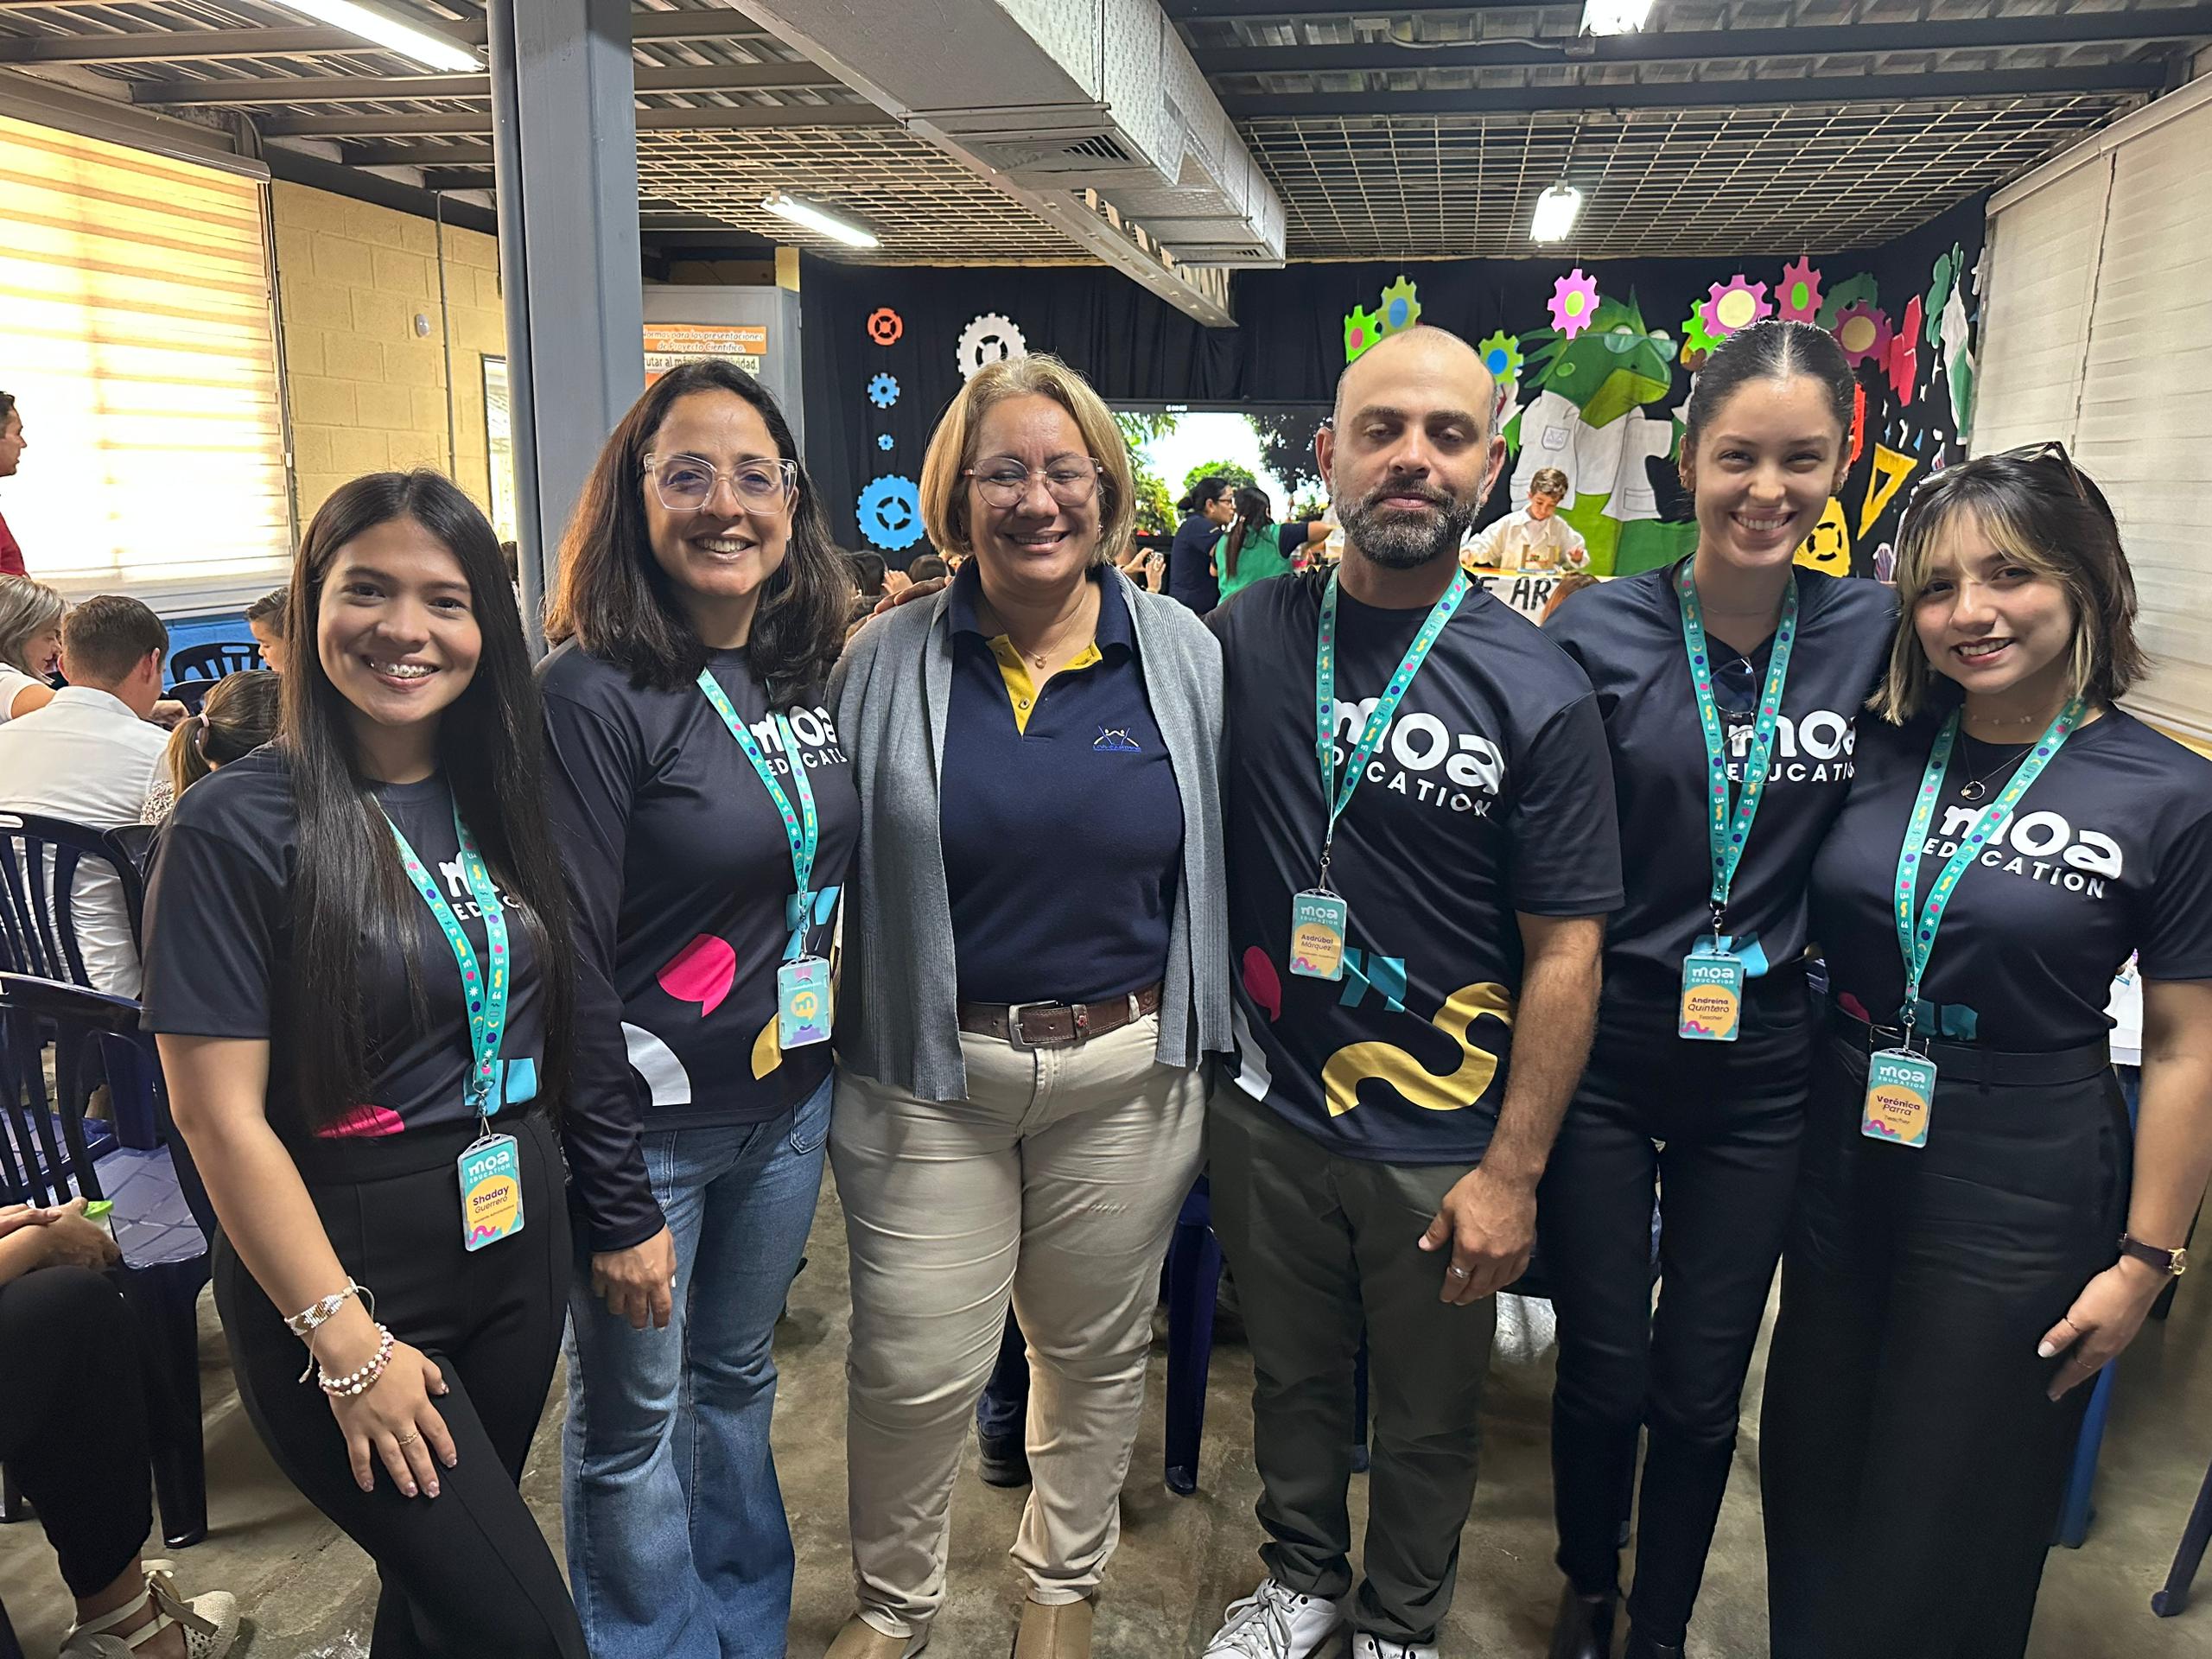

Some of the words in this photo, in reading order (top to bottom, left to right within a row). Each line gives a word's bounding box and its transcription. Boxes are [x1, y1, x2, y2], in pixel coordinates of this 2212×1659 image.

[665, 356, 673, 367] al
[1921, 838, 2106, 899] EDCATION
[1300, 906, 1338, 919] moa
[1693, 967, 1734, 979] moa
[1688, 1004, 1729, 1013] Quintero
[1879, 1065, 1925, 1084] moa
[1878, 1076, 1925, 1090] EDUCATION
[1877, 1095, 1921, 1110] Verónica
[1883, 1103, 1912, 1116] Parra
[468, 1151, 510, 1176] moa
[469, 1163, 511, 1184] EDUCATION
[473, 1185, 510, 1206] Shaday
[474, 1195, 508, 1214] Guerrero
